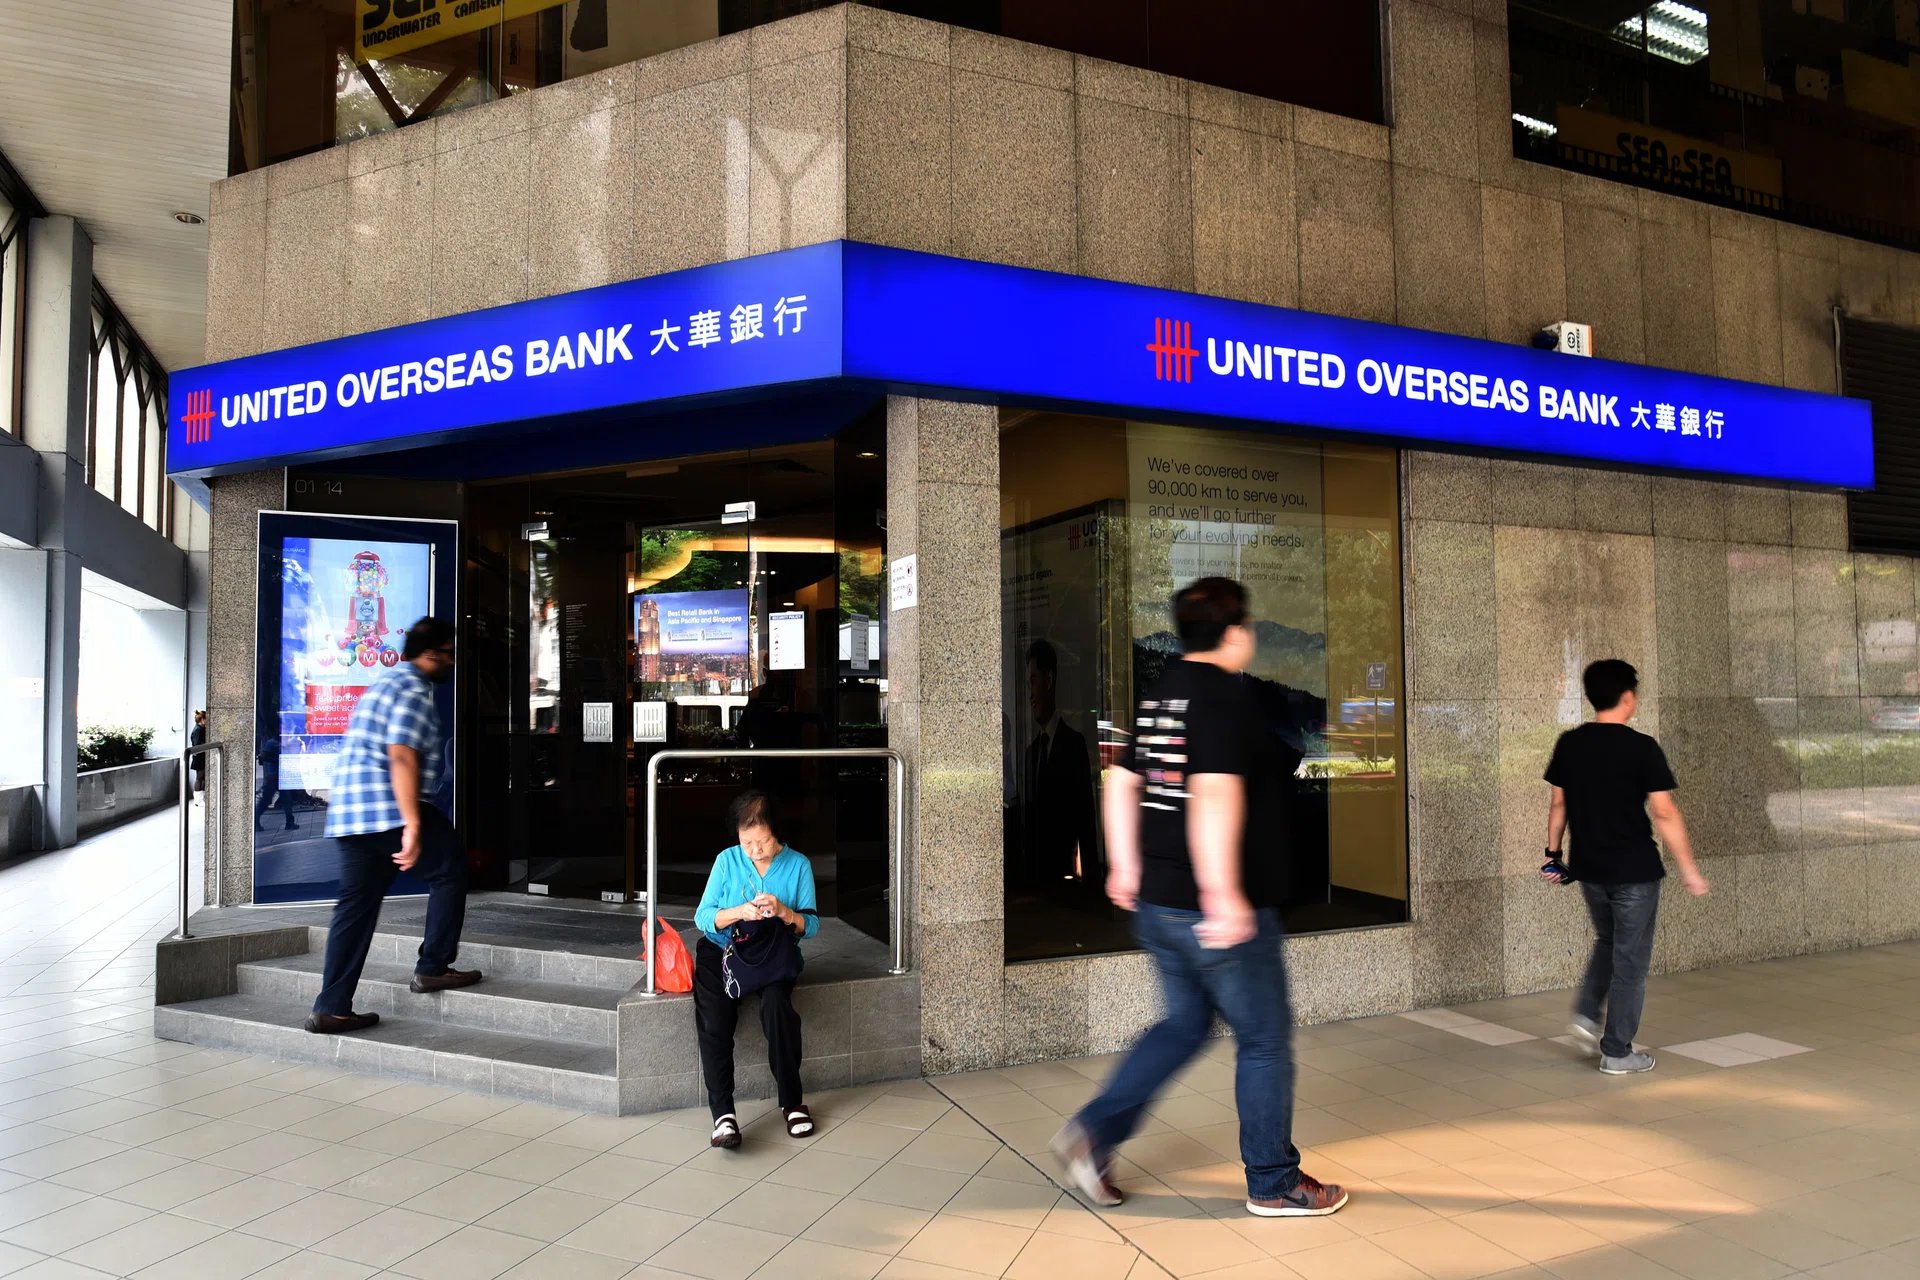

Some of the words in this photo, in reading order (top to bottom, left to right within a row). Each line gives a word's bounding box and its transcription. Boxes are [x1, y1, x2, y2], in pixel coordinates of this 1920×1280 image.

[362, 12, 441, 48] UNDERWATER
[649, 294, 808, 356] 大華銀行
[221, 380, 327, 428] UNITED
[336, 344, 514, 408] OVERSEAS
[525, 323, 633, 377] BANK
[1207, 337, 1346, 389] UNITED
[1356, 358, 1529, 414] OVERSEAS
[1539, 385, 1621, 428] BANK
[1630, 400, 1725, 439] 大華銀行
[1147, 456, 1191, 474] We've
[1194, 465, 1248, 480] covered
[1251, 469, 1280, 483] over
[295, 479, 315, 494] 01
[323, 480, 343, 496] 14
[1148, 479, 1197, 497] 90,000
[1201, 483, 1222, 500] km
[1226, 486, 1239, 501] to
[1243, 490, 1278, 504] serve
[1281, 493, 1308, 508] you,
[1148, 503, 1175, 519] and
[1179, 505, 1209, 520] we'll
[1213, 509, 1231, 524] go
[1235, 508, 1277, 525] further
[1082, 519, 1099, 538] UO
[1150, 524, 1167, 540] for
[1172, 528, 1201, 544] your
[1205, 529, 1259, 548] evolving
[1262, 533, 1305, 548] needs.
[712, 615, 742, 625] Singapore
[363, 653, 374, 663] M
[384, 653, 395, 663] M
